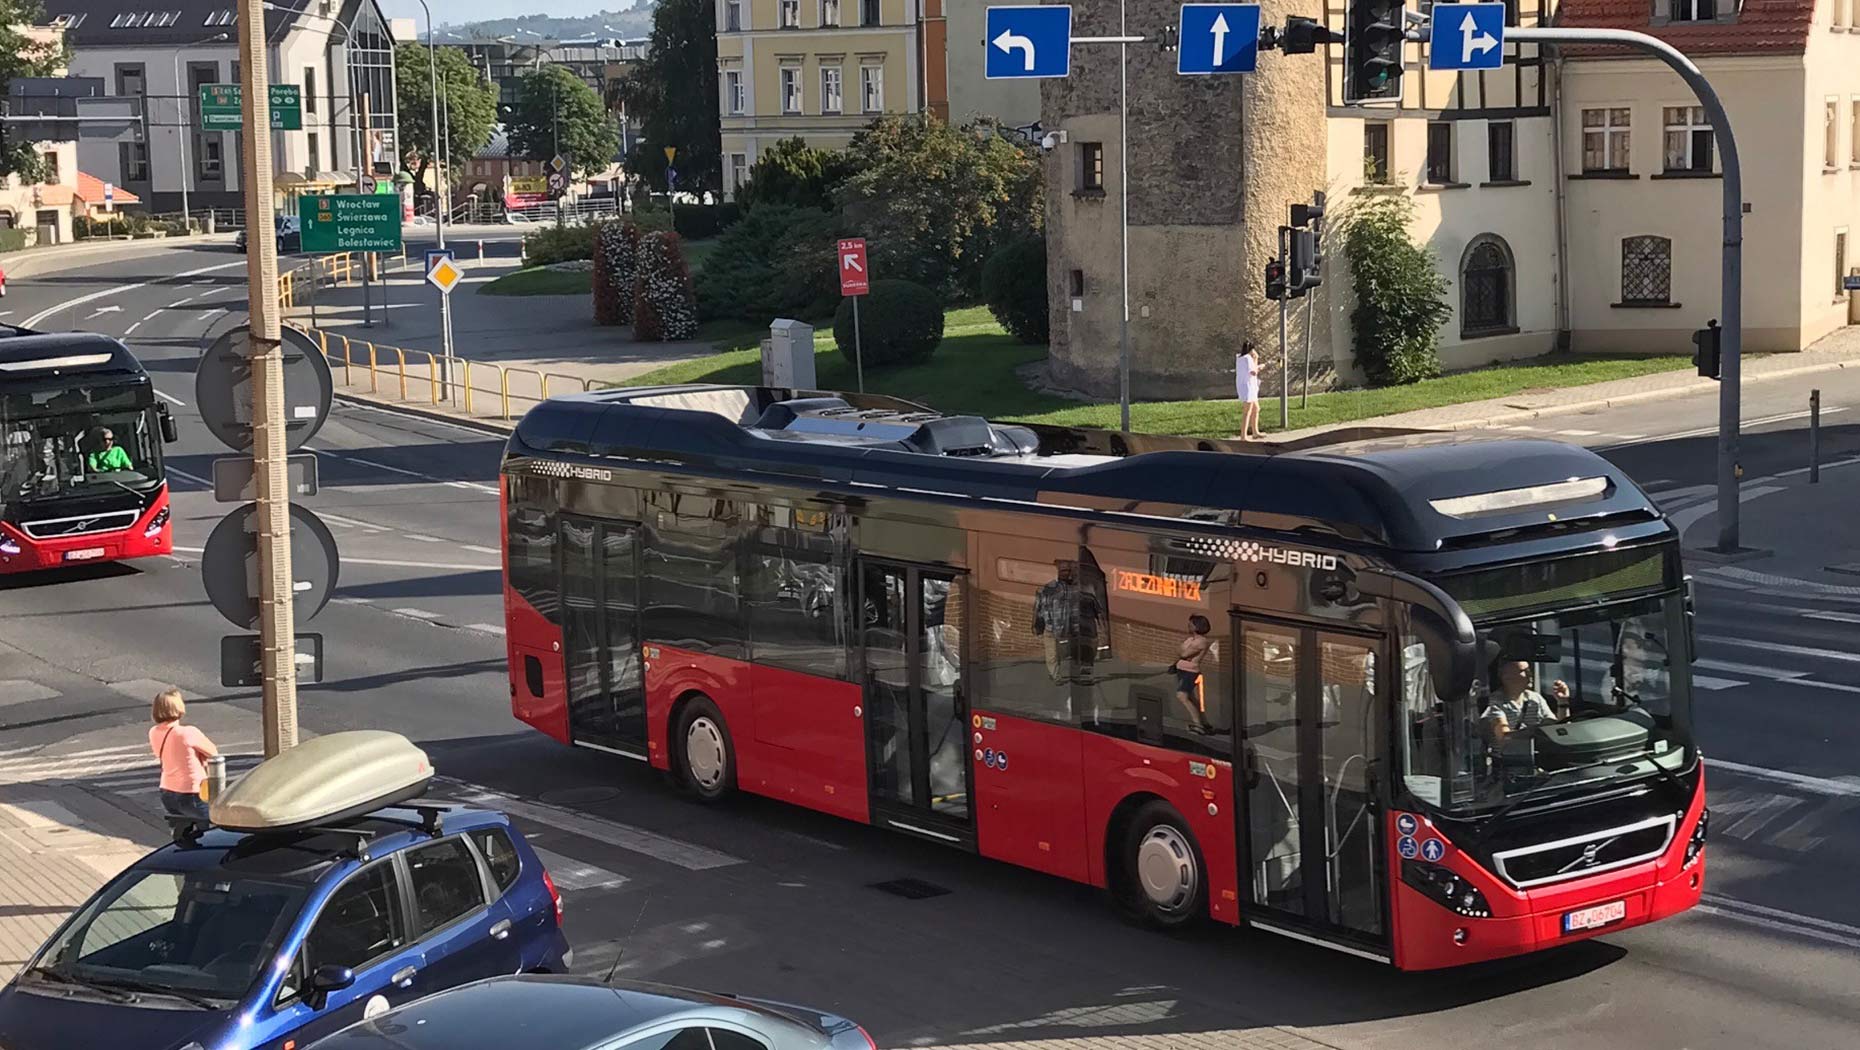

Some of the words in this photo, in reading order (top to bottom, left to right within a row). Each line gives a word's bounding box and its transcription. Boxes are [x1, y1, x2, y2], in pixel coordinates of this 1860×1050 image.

[336, 199, 380, 209] Wrocław
[336, 211, 388, 222] Świerzawa
[337, 226, 375, 236] Legnica
[338, 238, 394, 247] Bolesławiec
[570, 466, 611, 481] HYBRID
[1259, 546, 1337, 571] HYBRID
